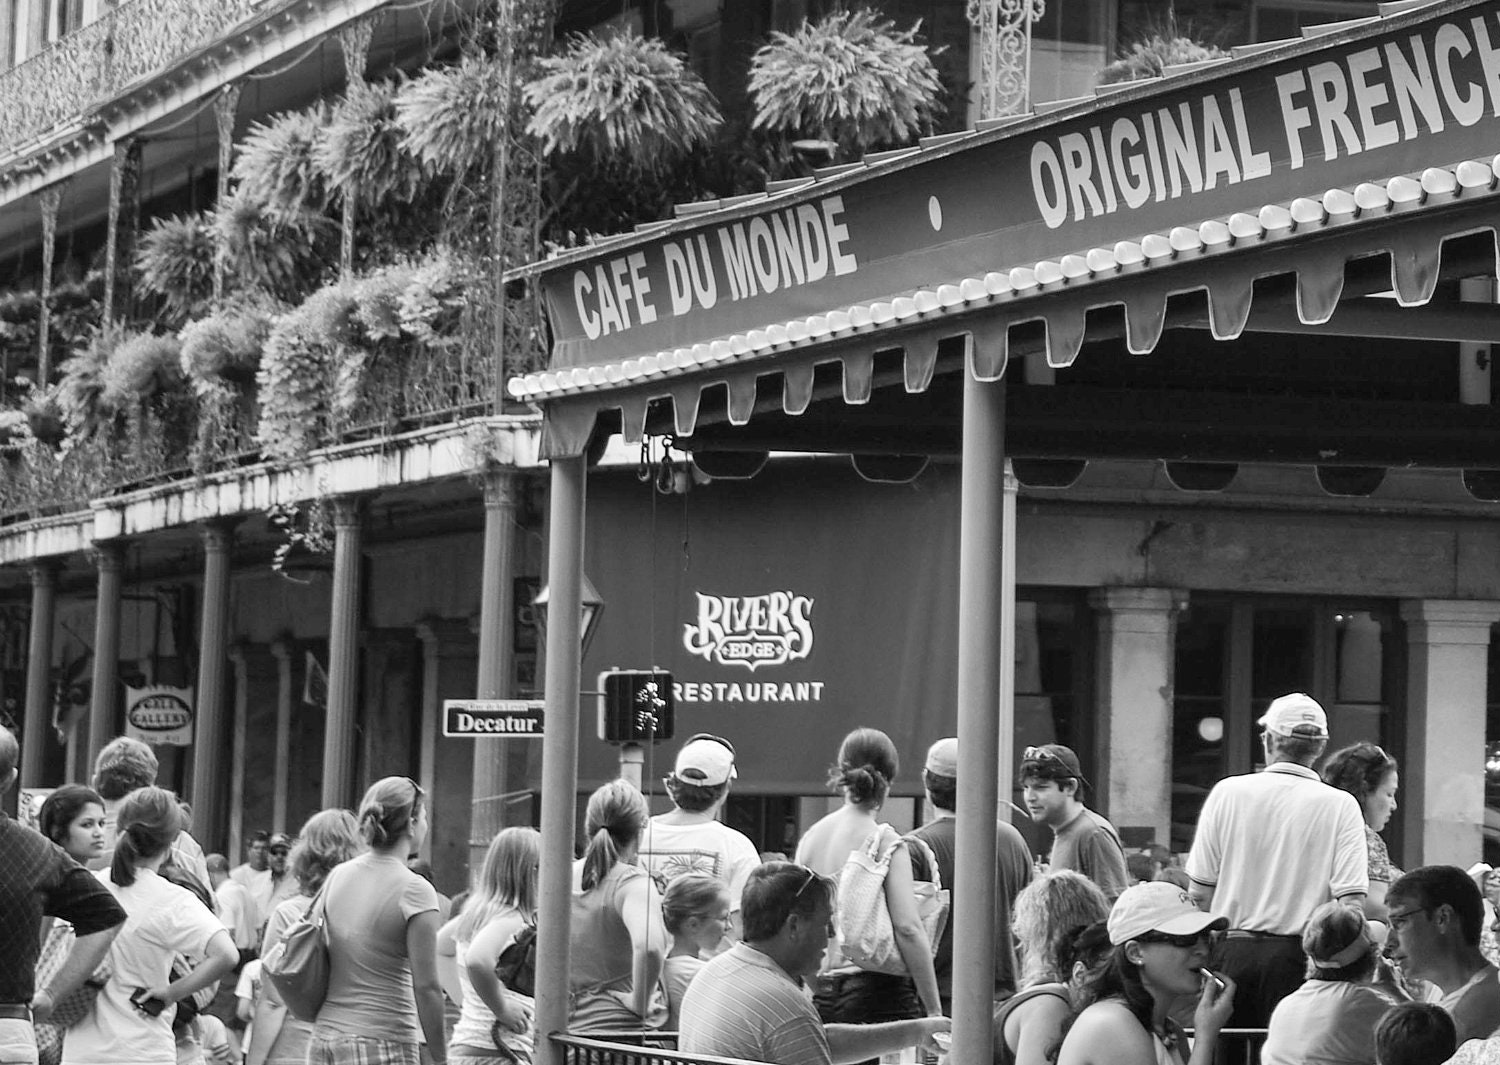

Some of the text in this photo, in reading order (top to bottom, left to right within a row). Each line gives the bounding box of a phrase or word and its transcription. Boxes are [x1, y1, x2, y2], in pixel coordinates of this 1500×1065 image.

[573, 251, 658, 340] CAFE
[663, 233, 718, 317] DU
[718, 195, 858, 302] MONDE
[1029, 85, 1272, 229] ORIGINAL
[683, 591, 814, 661] RIVER'S
[728, 642, 775, 658] EDGE
[673, 682, 825, 702] RESTAURANT
[458, 713, 538, 732] Decatur
